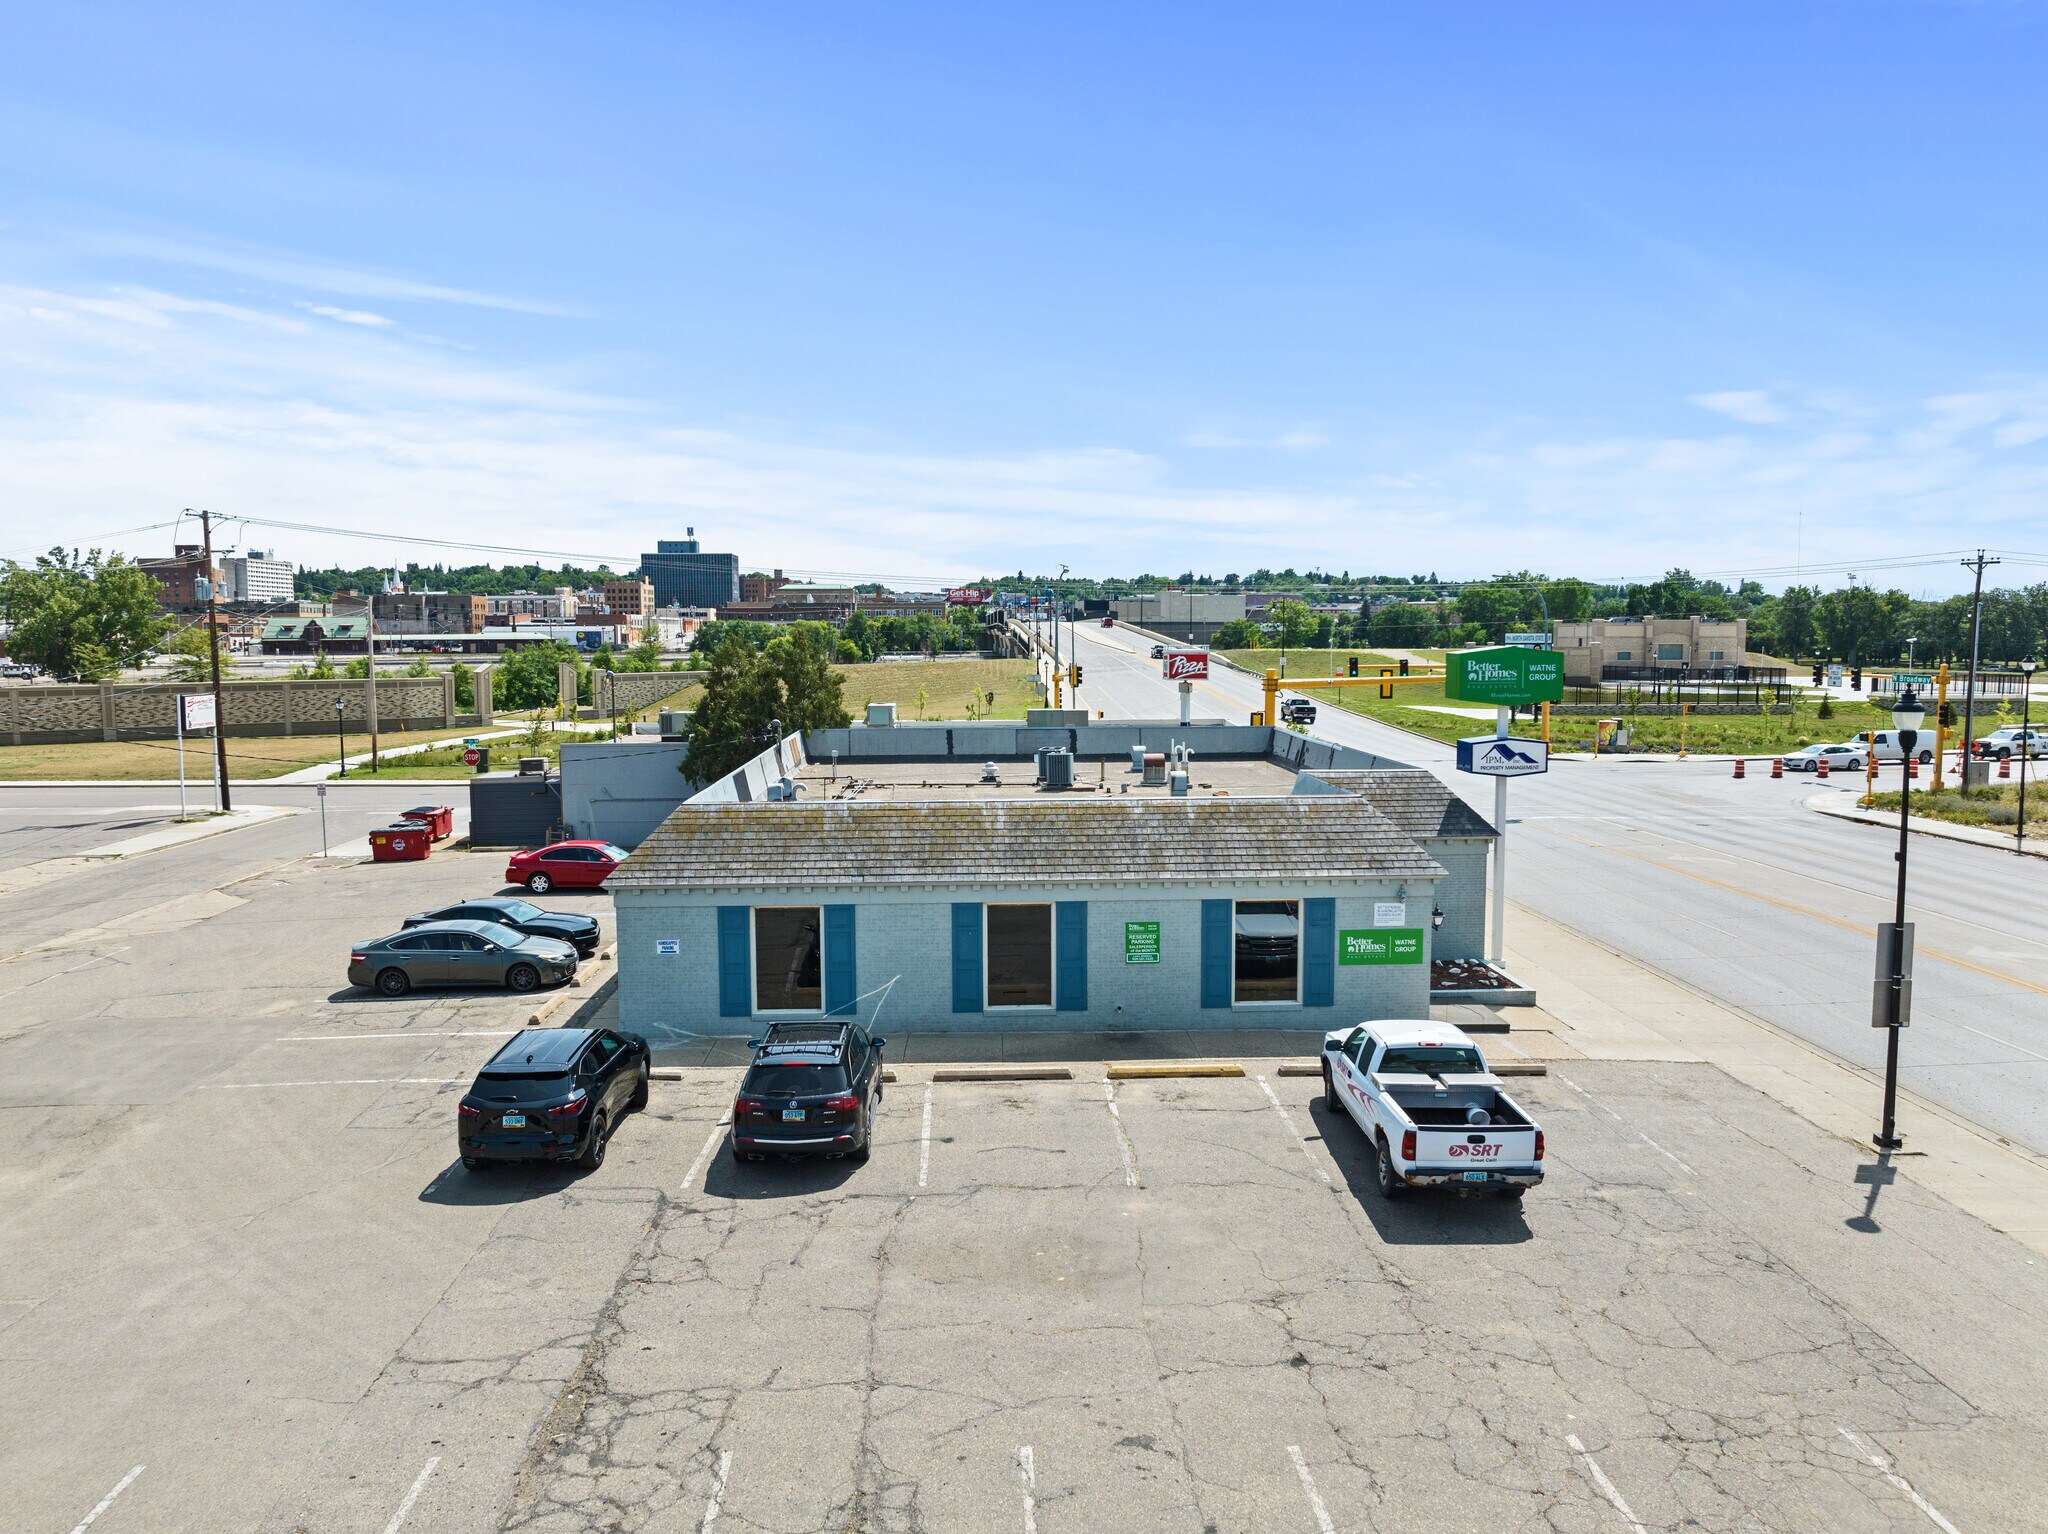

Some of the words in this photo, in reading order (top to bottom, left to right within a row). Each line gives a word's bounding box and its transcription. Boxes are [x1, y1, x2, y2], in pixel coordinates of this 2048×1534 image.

[966, 589, 979, 598] Hip
[1467, 660, 1501, 671] Better
[1529, 664, 1557, 672] WATNE
[1478, 670, 1517, 681] Homes
[1529, 673, 1557, 681] GROUP
[1899, 675, 1931, 683] Broadway
[464, 753, 479, 761] STOP
[1347, 936, 1374, 946] Better
[1355, 943, 1386, 953] Homes
[1470, 1144, 1503, 1157] SRT
